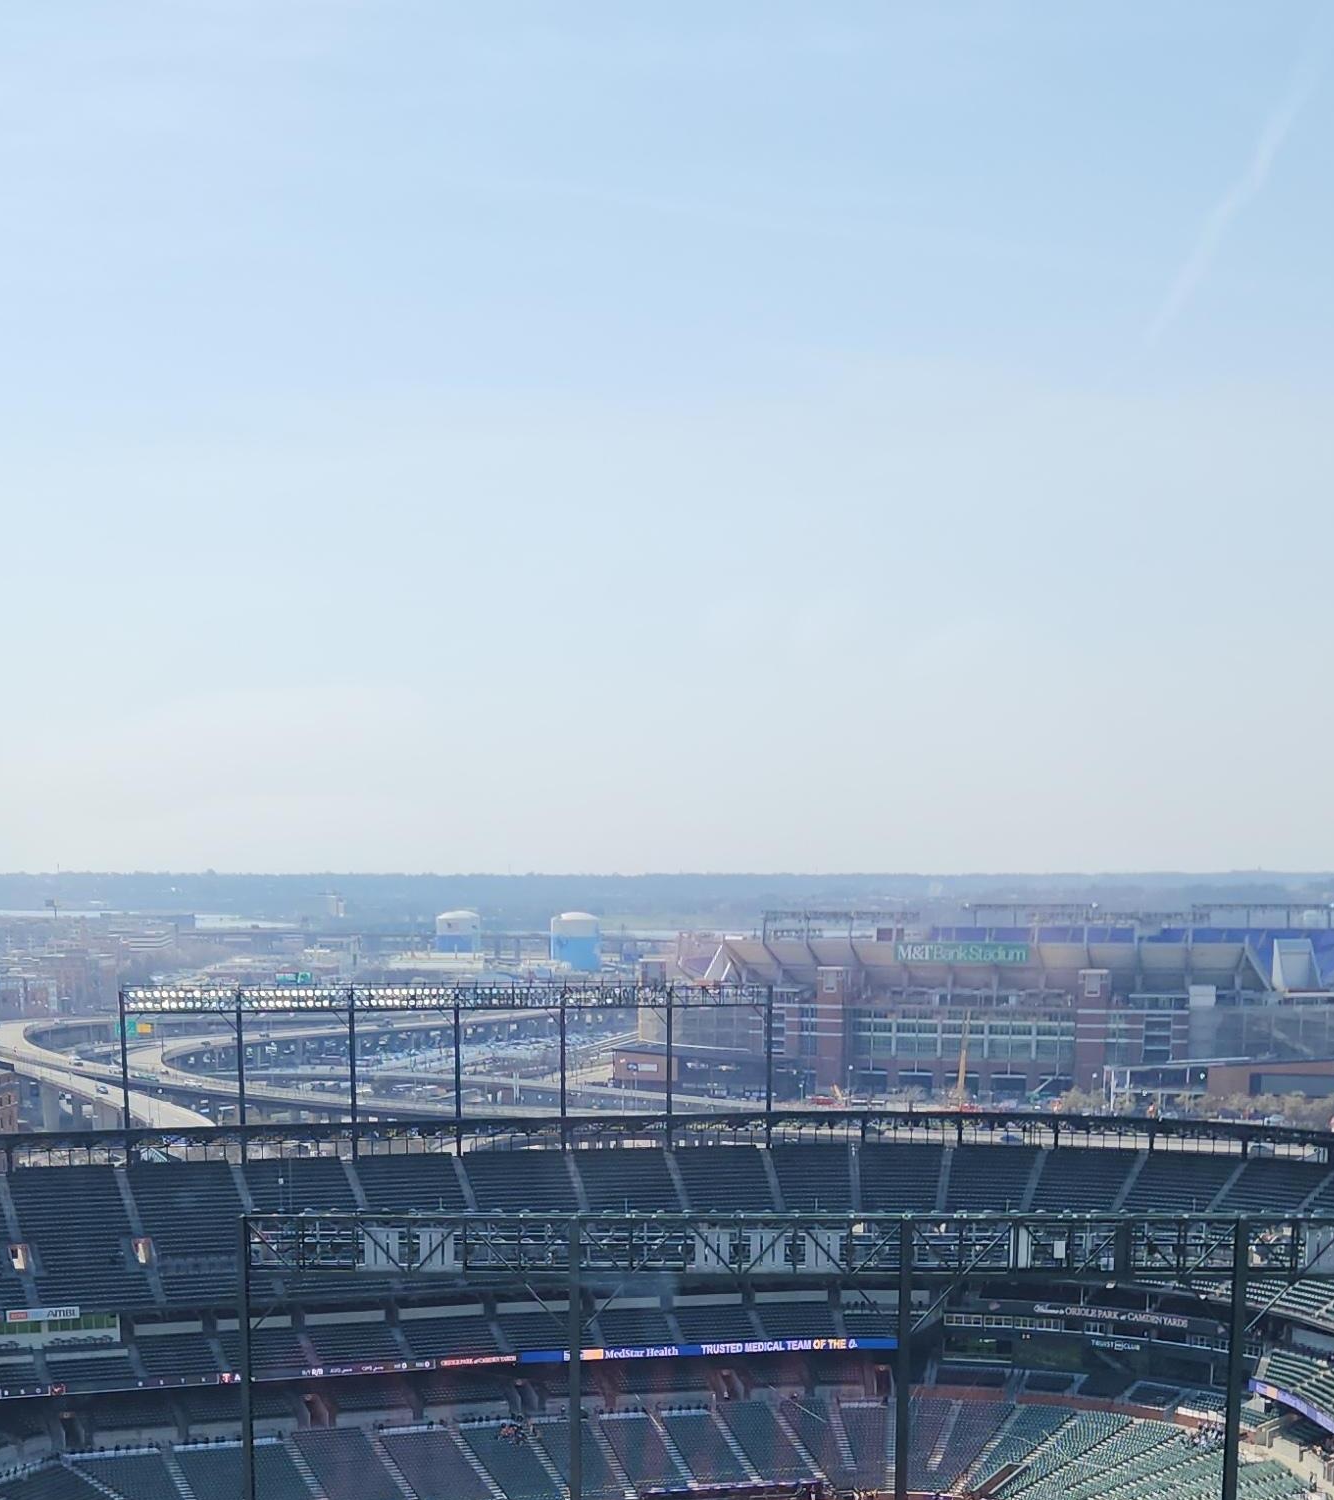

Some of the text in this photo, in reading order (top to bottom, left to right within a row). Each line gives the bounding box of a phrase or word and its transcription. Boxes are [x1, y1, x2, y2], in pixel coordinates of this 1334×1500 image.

[897, 944, 1027, 962] M&T Bank Stadium
[1065, 1306, 1097, 1318] ORIOLE
[1098, 1310, 1119, 1321] PARK
[1127, 1312, 1162, 1325] CAMDEN
[1163, 1317, 1189, 1329] YARDS
[604, 1346, 679, 1360] MedStar Health
[701, 1338, 846, 1355] TRUSTED MEDICAL TEAM OF THE
